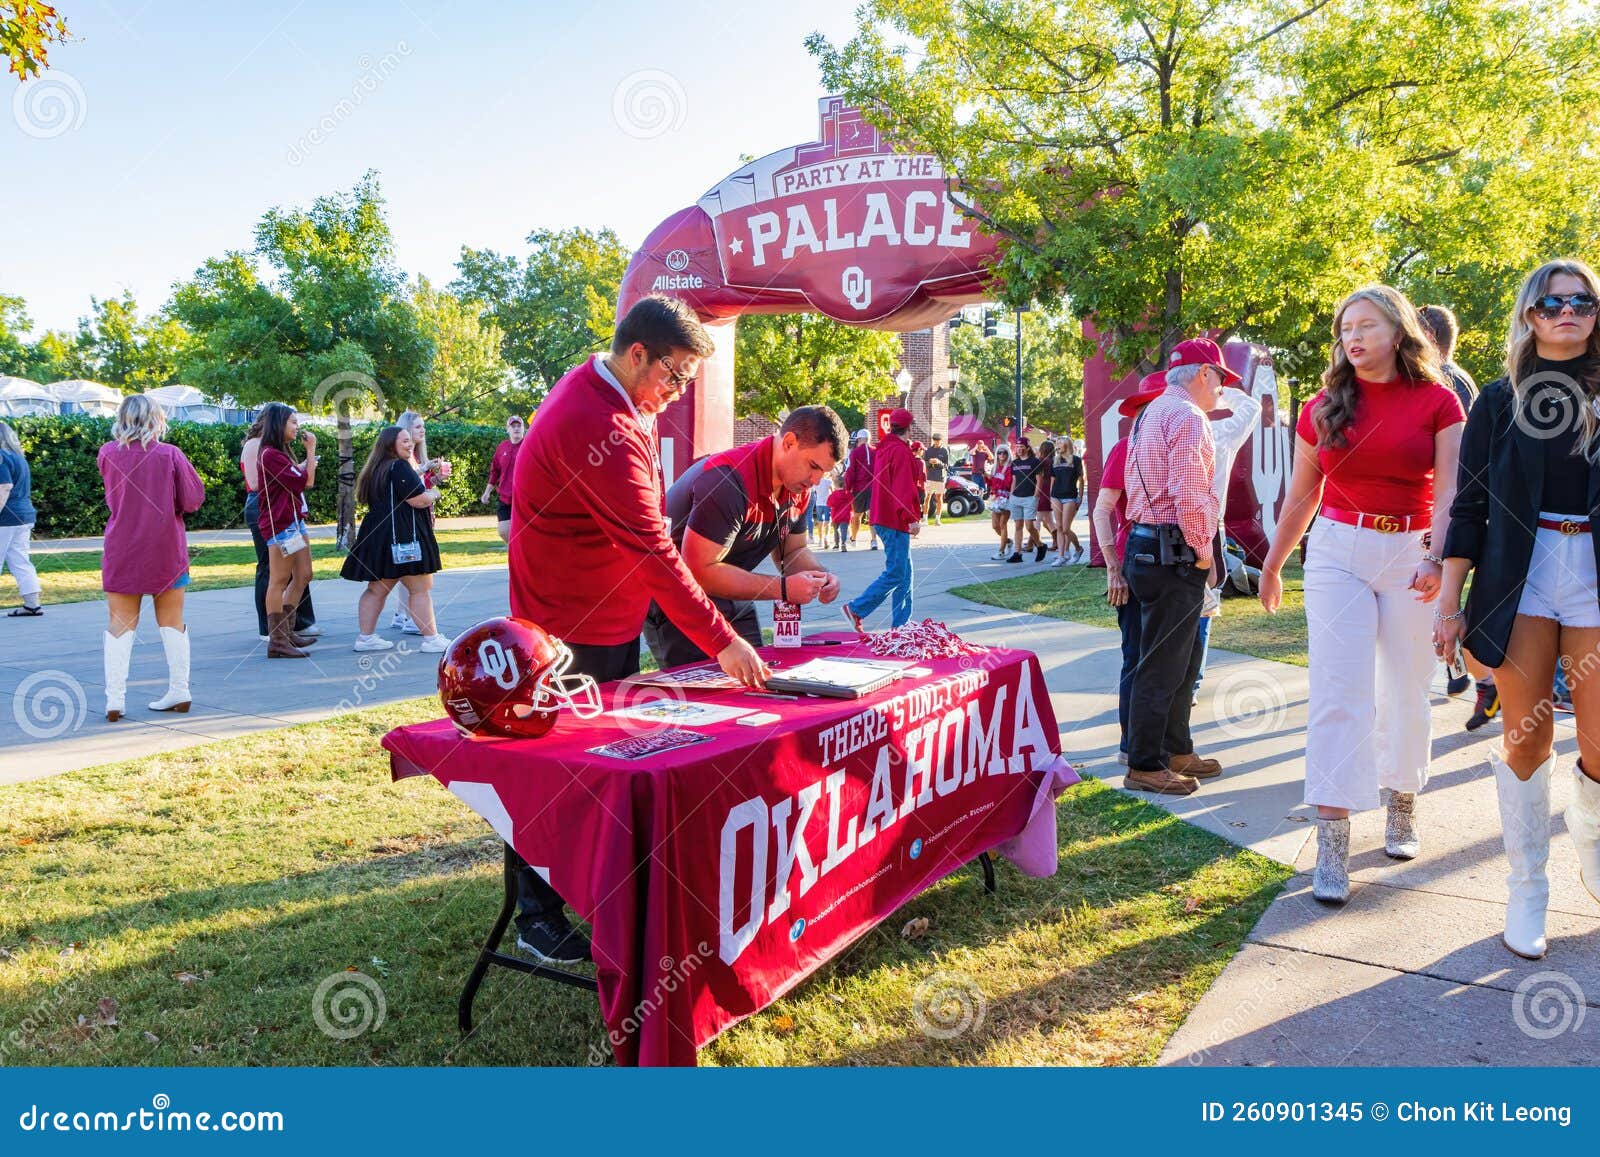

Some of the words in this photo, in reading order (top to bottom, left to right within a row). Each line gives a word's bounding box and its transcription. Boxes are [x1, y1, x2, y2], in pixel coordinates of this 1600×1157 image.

[784, 162, 850, 193] PARTY
[857, 159, 885, 179] AT
[893, 156, 934, 177] THE
[747, 190, 975, 267] PALACE
[652, 273, 703, 290] Allstate
[841, 266, 872, 310] OU
[881, 413, 891, 434] O
[478, 639, 520, 690] OU
[818, 695, 905, 768] THERE'S
[719, 658, 1060, 967] OKLAHOMA
